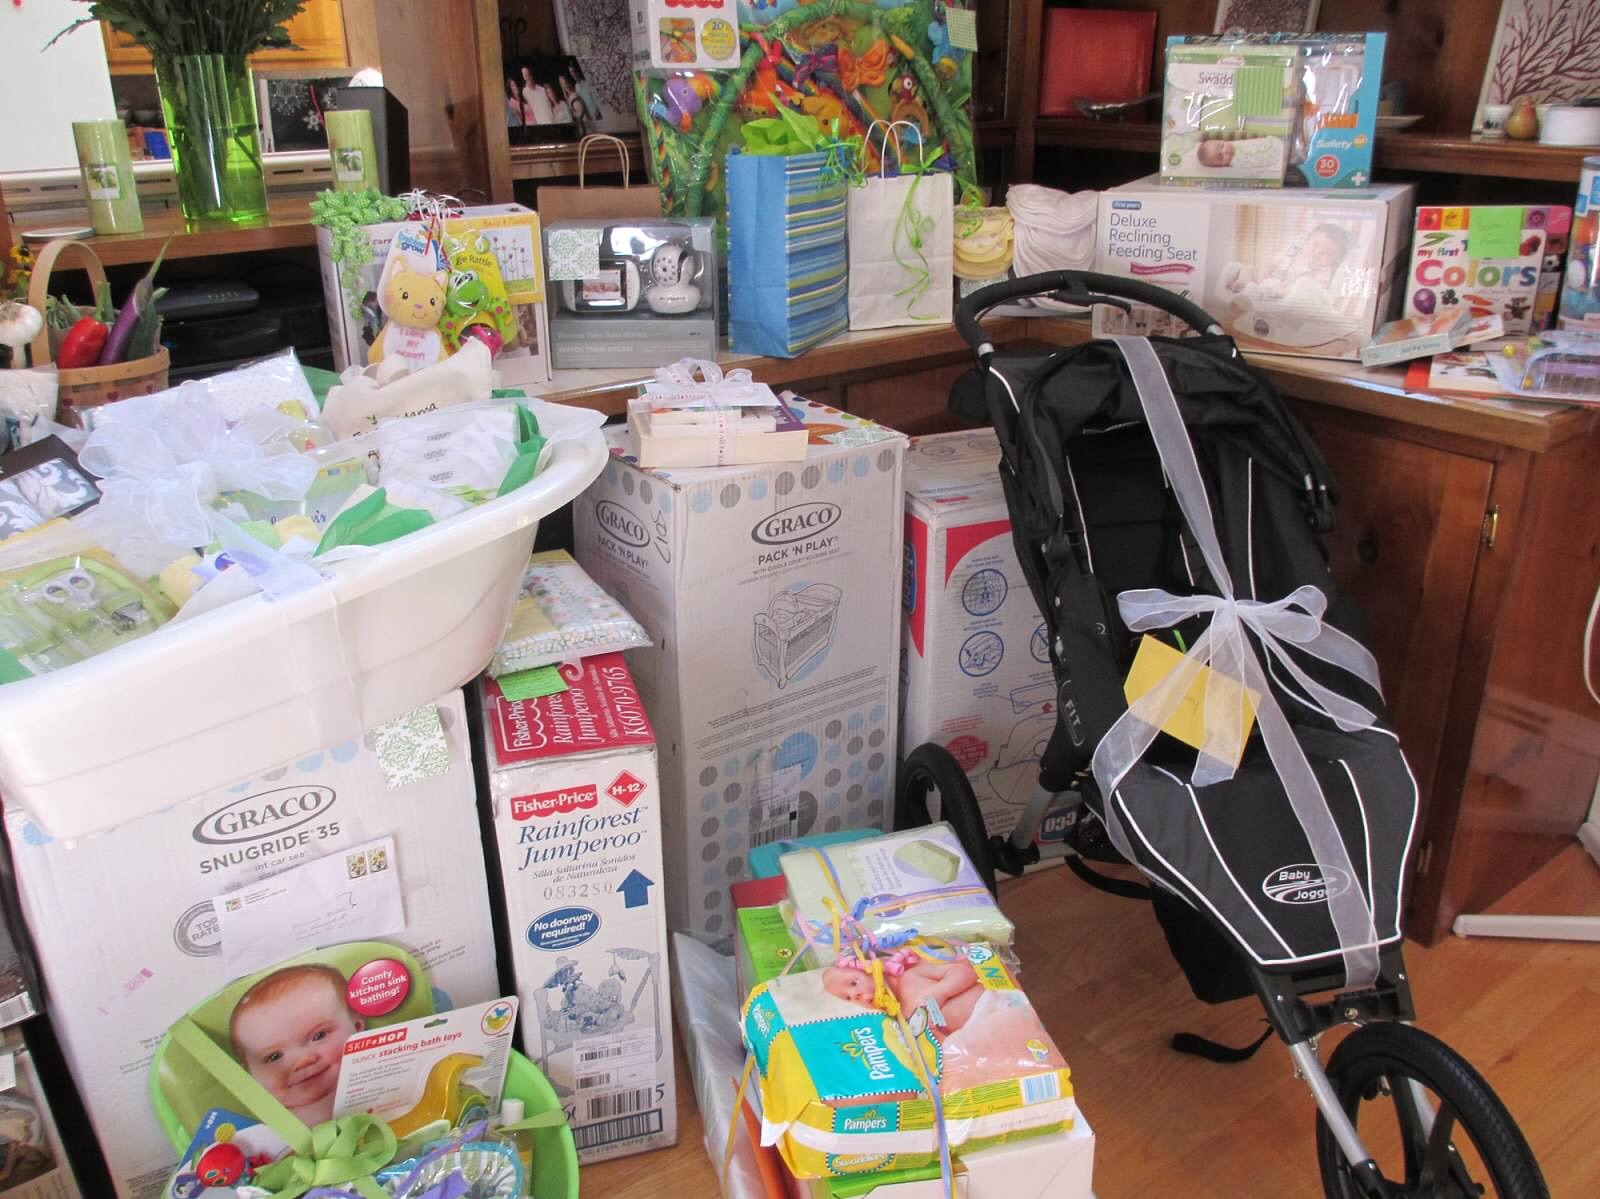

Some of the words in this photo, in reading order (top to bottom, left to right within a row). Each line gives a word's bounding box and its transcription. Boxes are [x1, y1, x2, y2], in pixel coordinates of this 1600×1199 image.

[1198, 71, 1233, 86] Swadd
[1315, 138, 1353, 151] Safety
[1320, 158, 1334, 170] 30
[1110, 213, 1157, 229] Deluxe
[372, 238, 392, 246] carr
[1109, 229, 1171, 246] Reclining
[1108, 244, 1162, 262] Feeding
[1167, 246, 1198, 262] Seat
[1417, 248, 1433, 258] my
[1439, 246, 1459, 257] first
[1415, 258, 1537, 288] Colors
[601, 505, 644, 541] GRACO
[765, 508, 832, 537] GRACO
[758, 549, 789, 566] PACK
[792, 544, 803, 556] 'N
[806, 537, 833, 553] PLAY
[602, 666, 649, 737] K6070-9765
[546, 692, 574, 744] Rainfores
[569, 688, 607, 743] Jumperoo
[1064, 699, 1081, 727] FIT
[611, 782, 641, 796] H-12
[214, 791, 322, 836] GRACO
[514, 793, 595, 815] Fisher-Price
[518, 807, 640, 845] Rainforest
[199, 831, 311, 875] SNUGRIDE
[317, 821, 341, 840] 35
[518, 831, 642, 871] Jumperoo
[271, 857, 287, 868] car
[533, 869, 553, 880] Silla
[555, 860, 599, 876] Saltarina
[600, 854, 637, 867] Sonidos
[553, 875, 566, 884] de
[567, 866, 618, 881] Naturaleza
[1279, 870, 1311, 881] Baby
[196, 917, 219, 931] TOP
[534, 921, 549, 932] No
[550, 911, 594, 928] doorway
[541, 922, 586, 940] required!
[191, 926, 221, 942] RATE
[350, 982, 386, 999] kitchen
[387, 974, 408, 988] sink
[361, 969, 393, 985] Comfy
[359, 986, 401, 1006] bathing!
[378, 1030, 407, 1045] HOP
[378, 1041, 420, 1058] stacking
[420, 1036, 442, 1049] bath
[443, 1030, 464, 1043] toys
[854, 1027, 895, 1081] Pampers
[843, 1116, 887, 1131] Pampers
